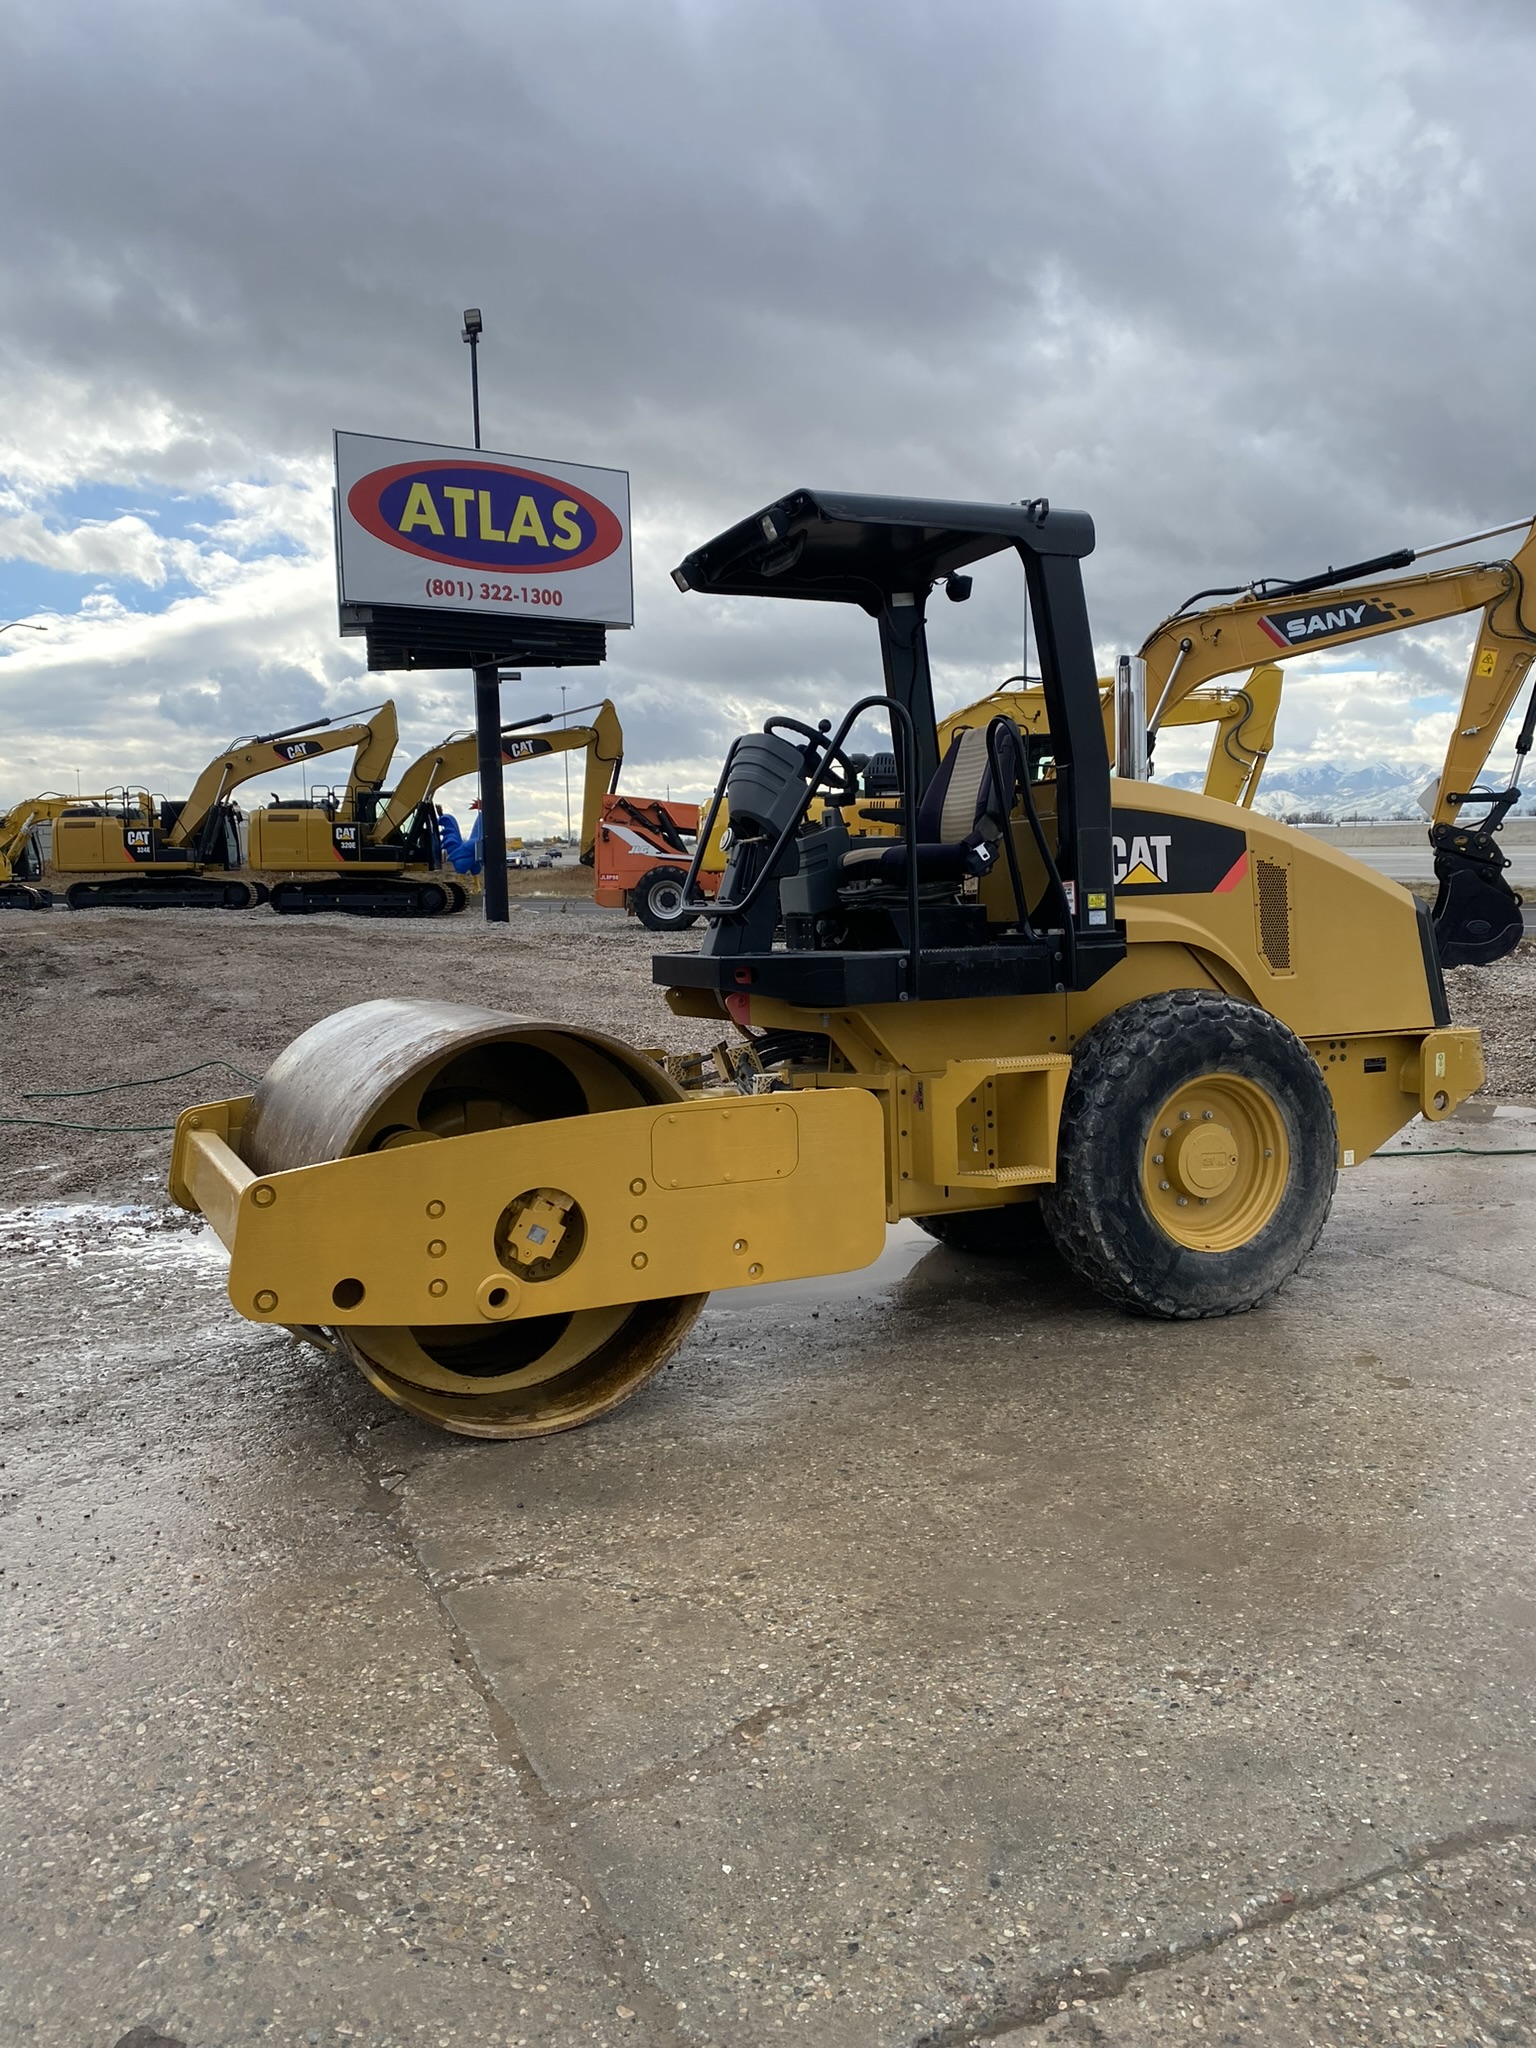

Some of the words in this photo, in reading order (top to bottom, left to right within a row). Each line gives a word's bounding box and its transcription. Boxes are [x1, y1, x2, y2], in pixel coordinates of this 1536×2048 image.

[398, 482, 582, 551] ATLAS
[425, 578, 474, 600] (801)
[479, 583, 563, 607] 322-1300
[1286, 604, 1367, 638] SANY
[286, 742, 308, 760] CAT
[511, 739, 534, 758] CAT
[127, 831, 150, 846] CAT
[335, 827, 356, 840] CAT
[1112, 835, 1172, 885] CAT
